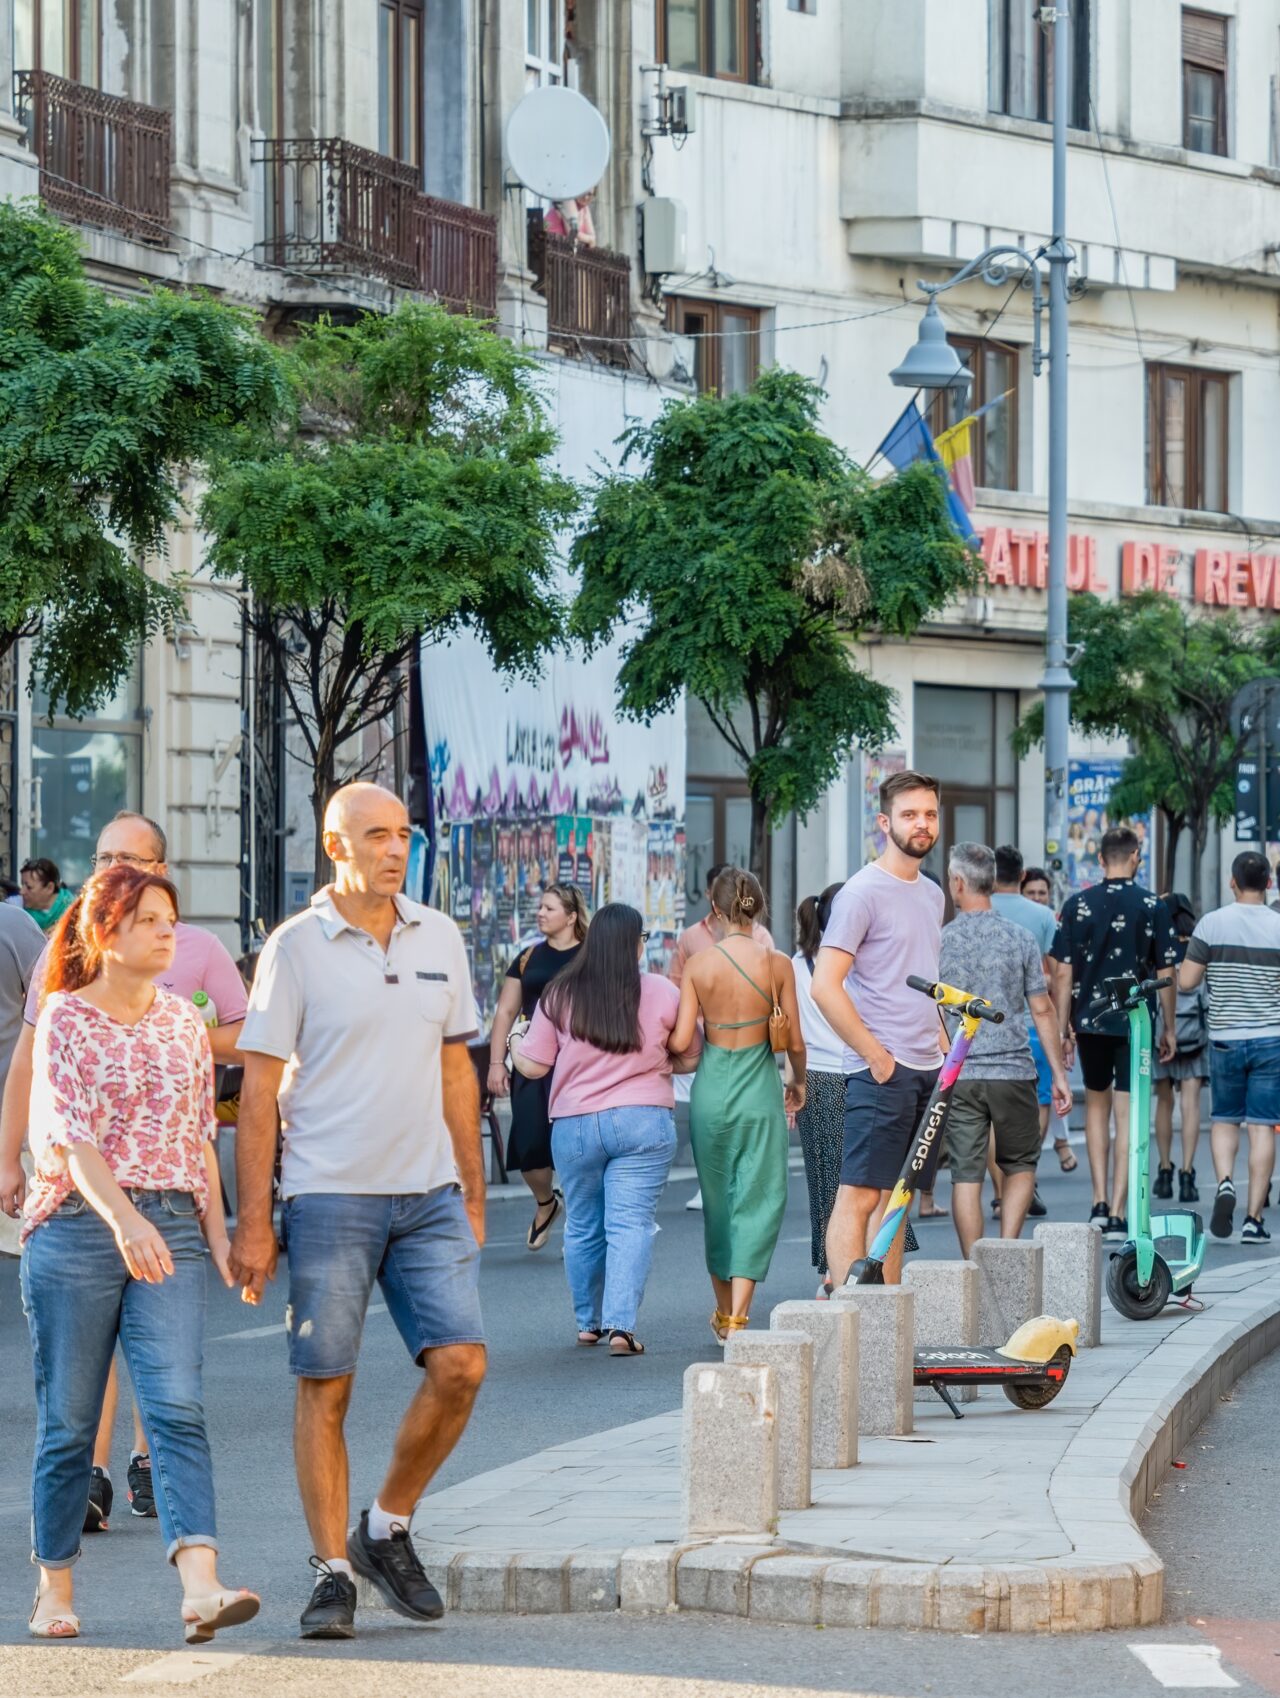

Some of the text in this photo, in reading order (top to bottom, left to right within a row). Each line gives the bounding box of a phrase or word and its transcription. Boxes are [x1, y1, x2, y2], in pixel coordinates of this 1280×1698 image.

[1121, 541, 1180, 598] DE
[1139, 1047, 1152, 1076] Bolt
[911, 1101, 947, 1171] splash
